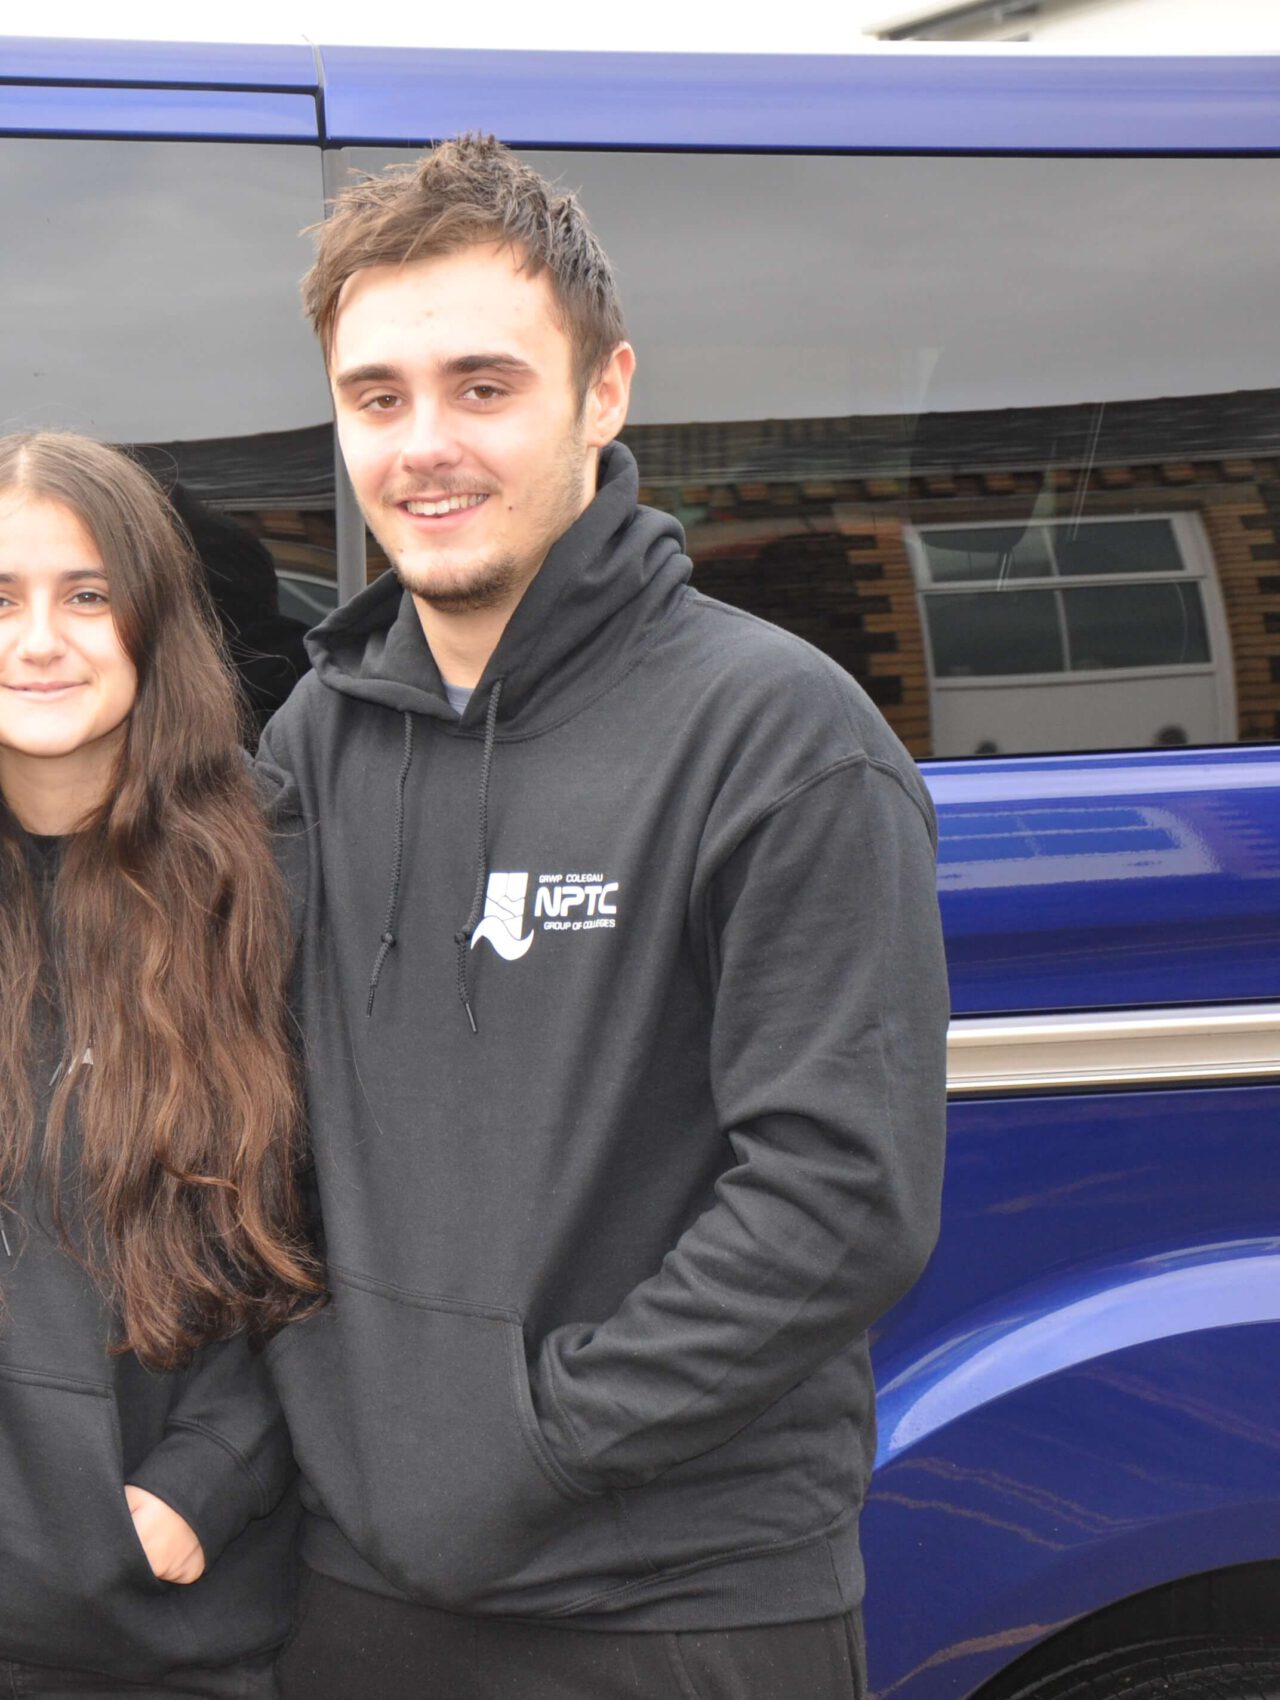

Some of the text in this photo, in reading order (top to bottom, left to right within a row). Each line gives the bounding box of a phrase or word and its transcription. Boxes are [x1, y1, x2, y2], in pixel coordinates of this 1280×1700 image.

[539, 873, 604, 883] GRWP COLEGAU
[534, 882, 619, 917] NPTC
[543, 918, 616, 930] GROUP OF COLLEGES
